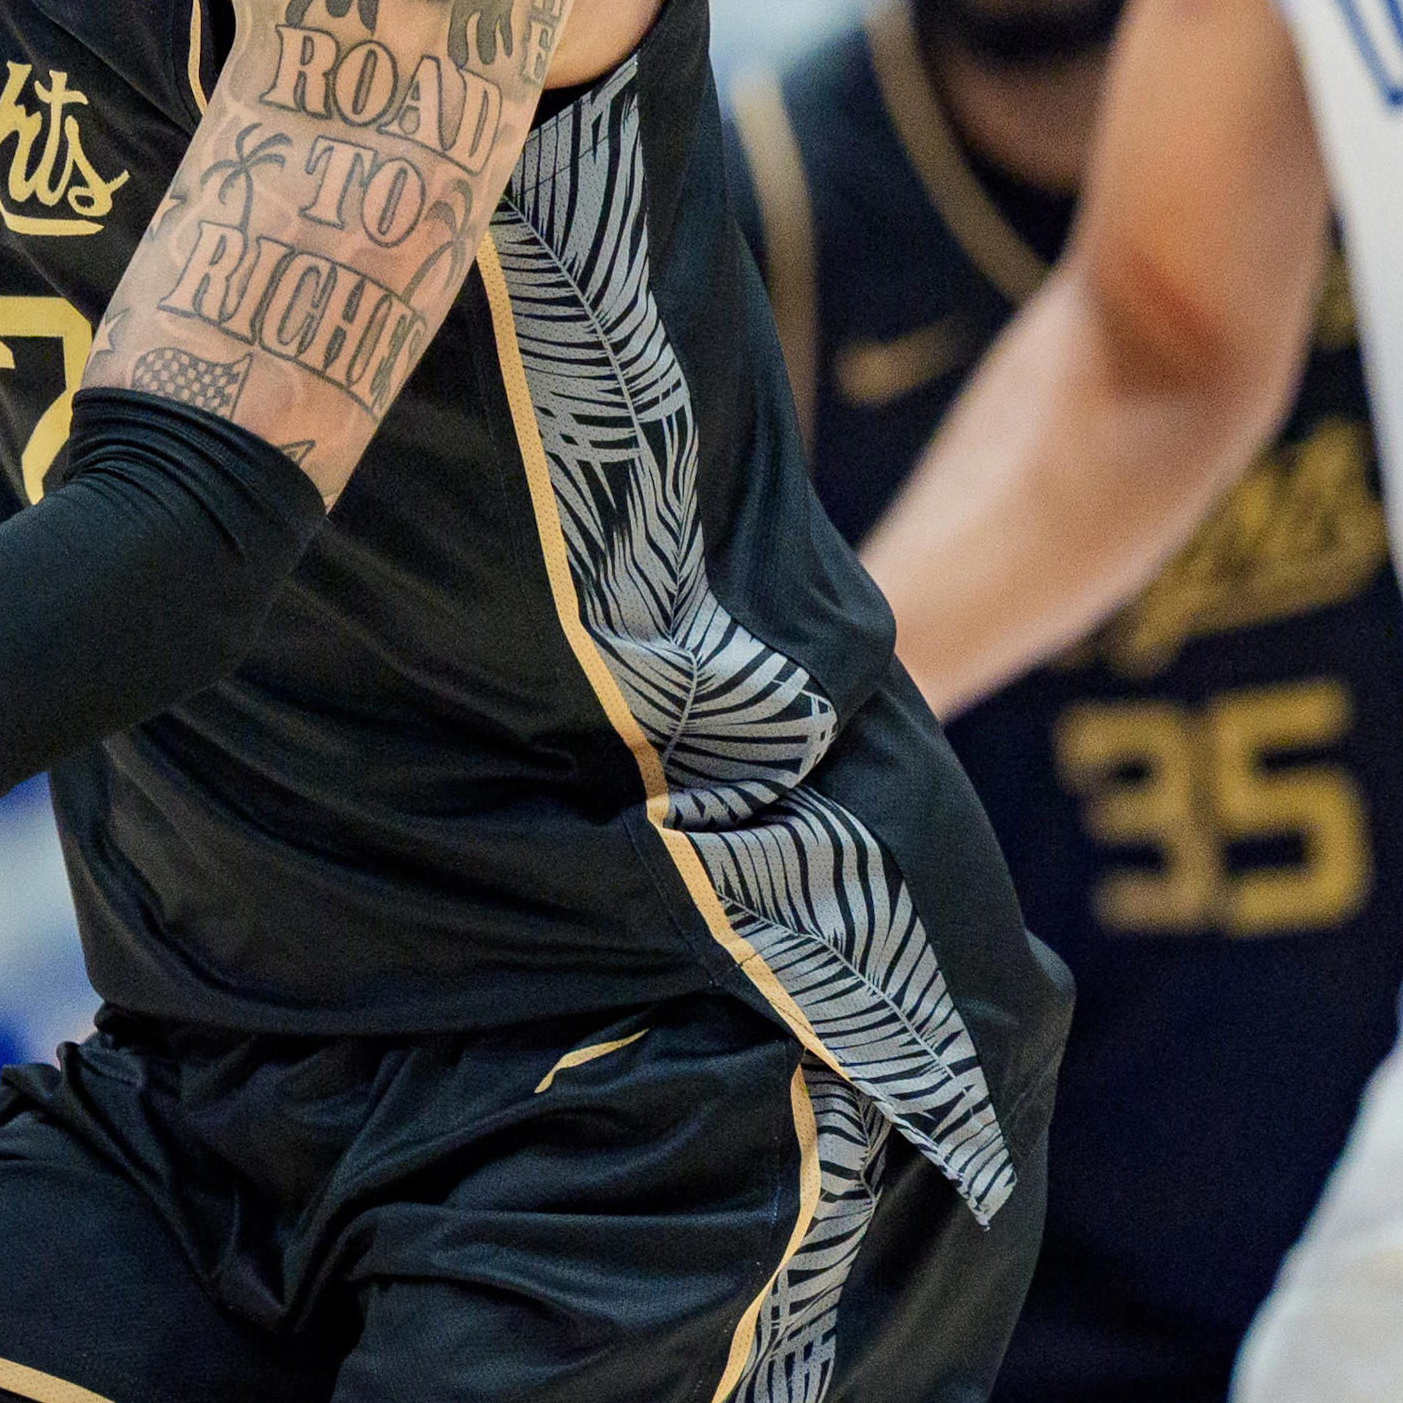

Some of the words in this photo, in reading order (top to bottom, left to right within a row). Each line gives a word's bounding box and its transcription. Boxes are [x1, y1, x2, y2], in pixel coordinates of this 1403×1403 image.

[259, 24, 502, 177] ROAD
[299, 135, 426, 248] TO
[1058, 680, 1368, 932] 35
